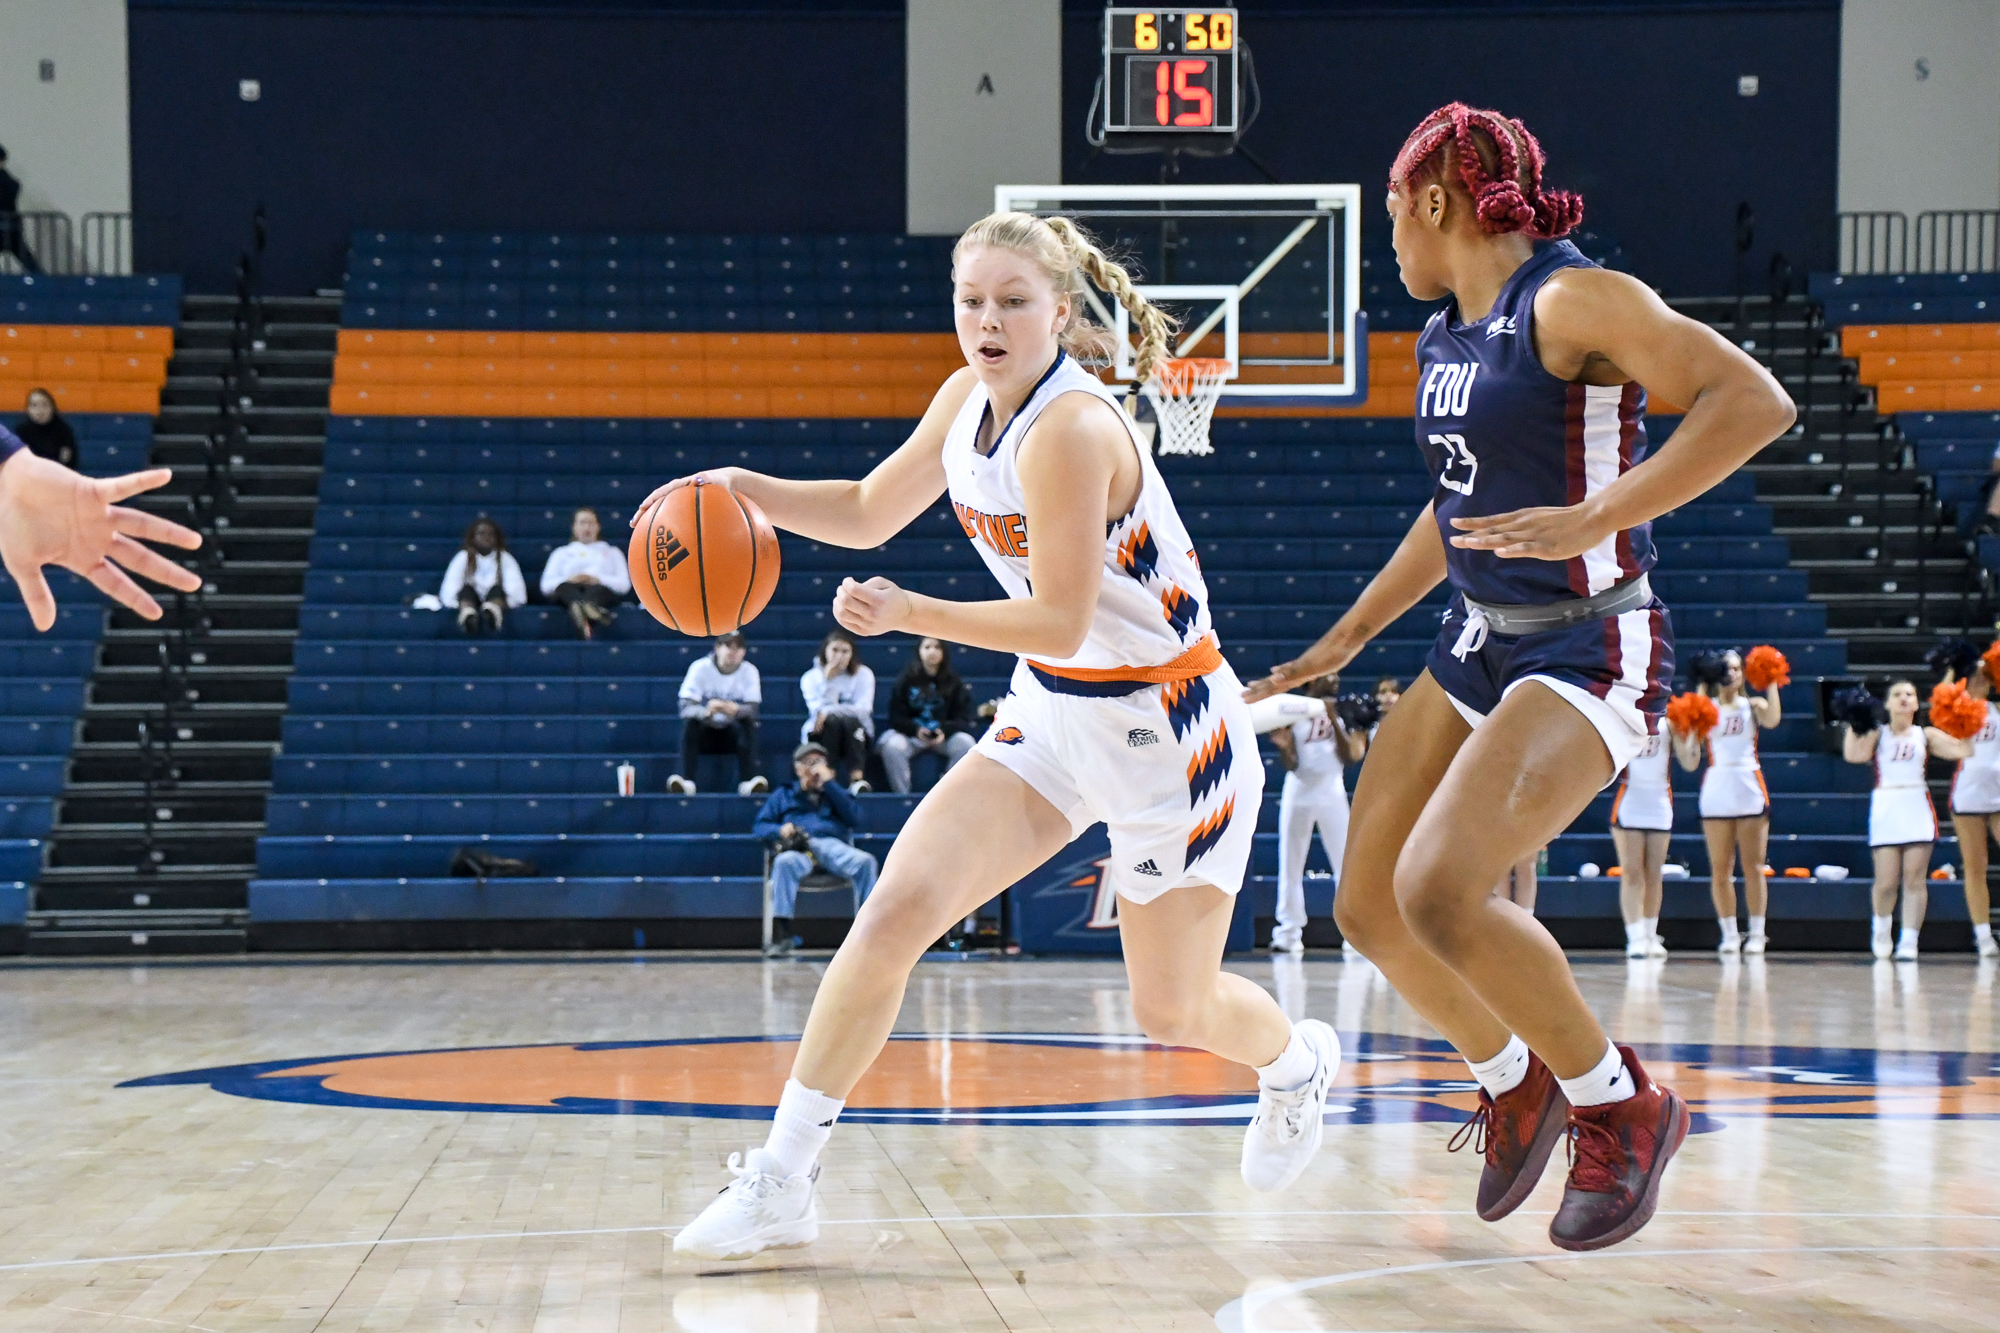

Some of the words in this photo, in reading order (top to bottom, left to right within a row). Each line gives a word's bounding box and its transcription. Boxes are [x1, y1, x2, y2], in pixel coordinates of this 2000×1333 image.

[976, 73, 995, 96] A
[1156, 60, 1213, 126] 15
[1421, 362, 1480, 417] FDU
[1428, 434, 1478, 496] 23
[656, 525, 667, 581] adidas
[954, 501, 1029, 557] UCKNE
[1133, 866, 1162, 876] adidas
